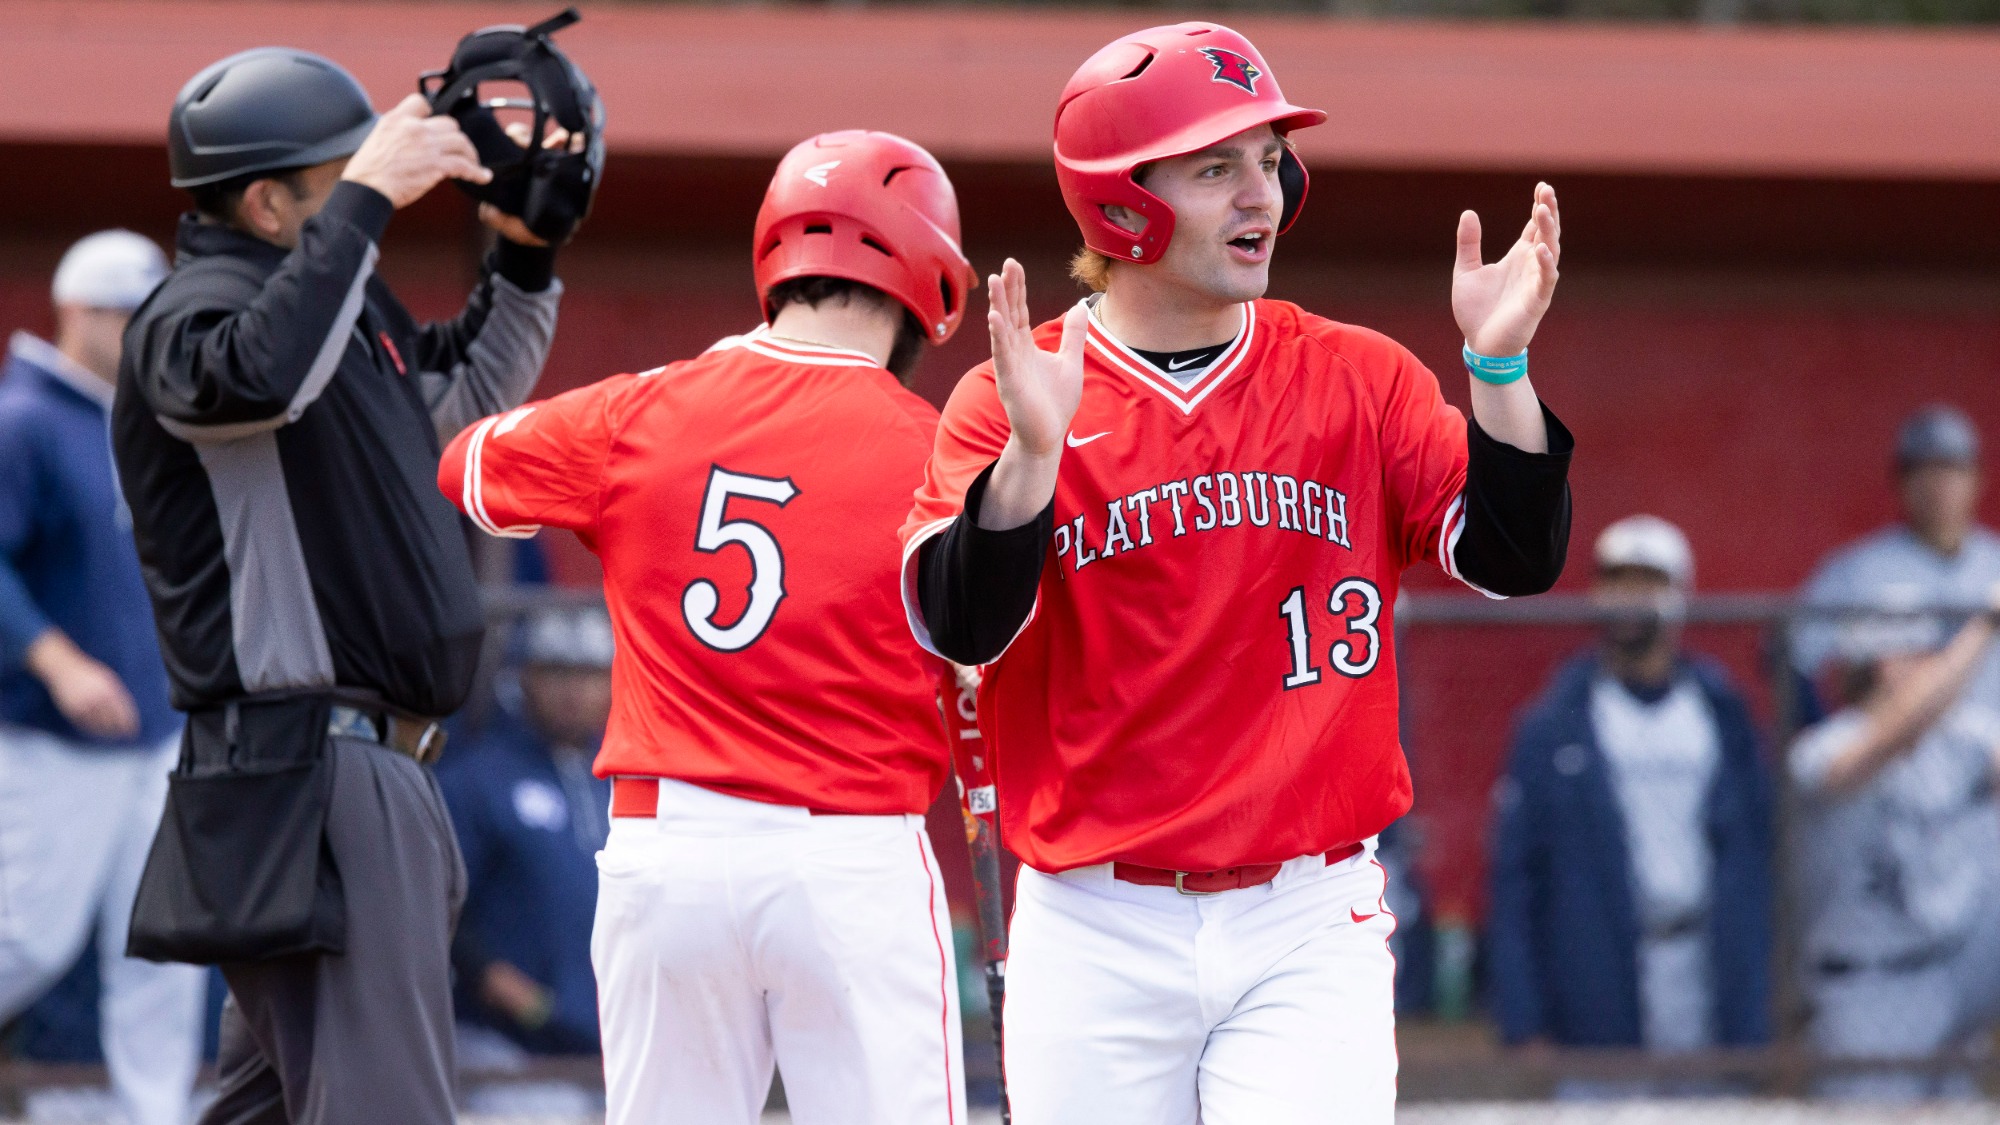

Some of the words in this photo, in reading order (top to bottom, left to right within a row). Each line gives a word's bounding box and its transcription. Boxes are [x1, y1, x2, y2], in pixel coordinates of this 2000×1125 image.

[680, 462, 803, 654] 5
[1053, 470, 1352, 579] PLATTSBURGH
[1278, 576, 1382, 691] 13
